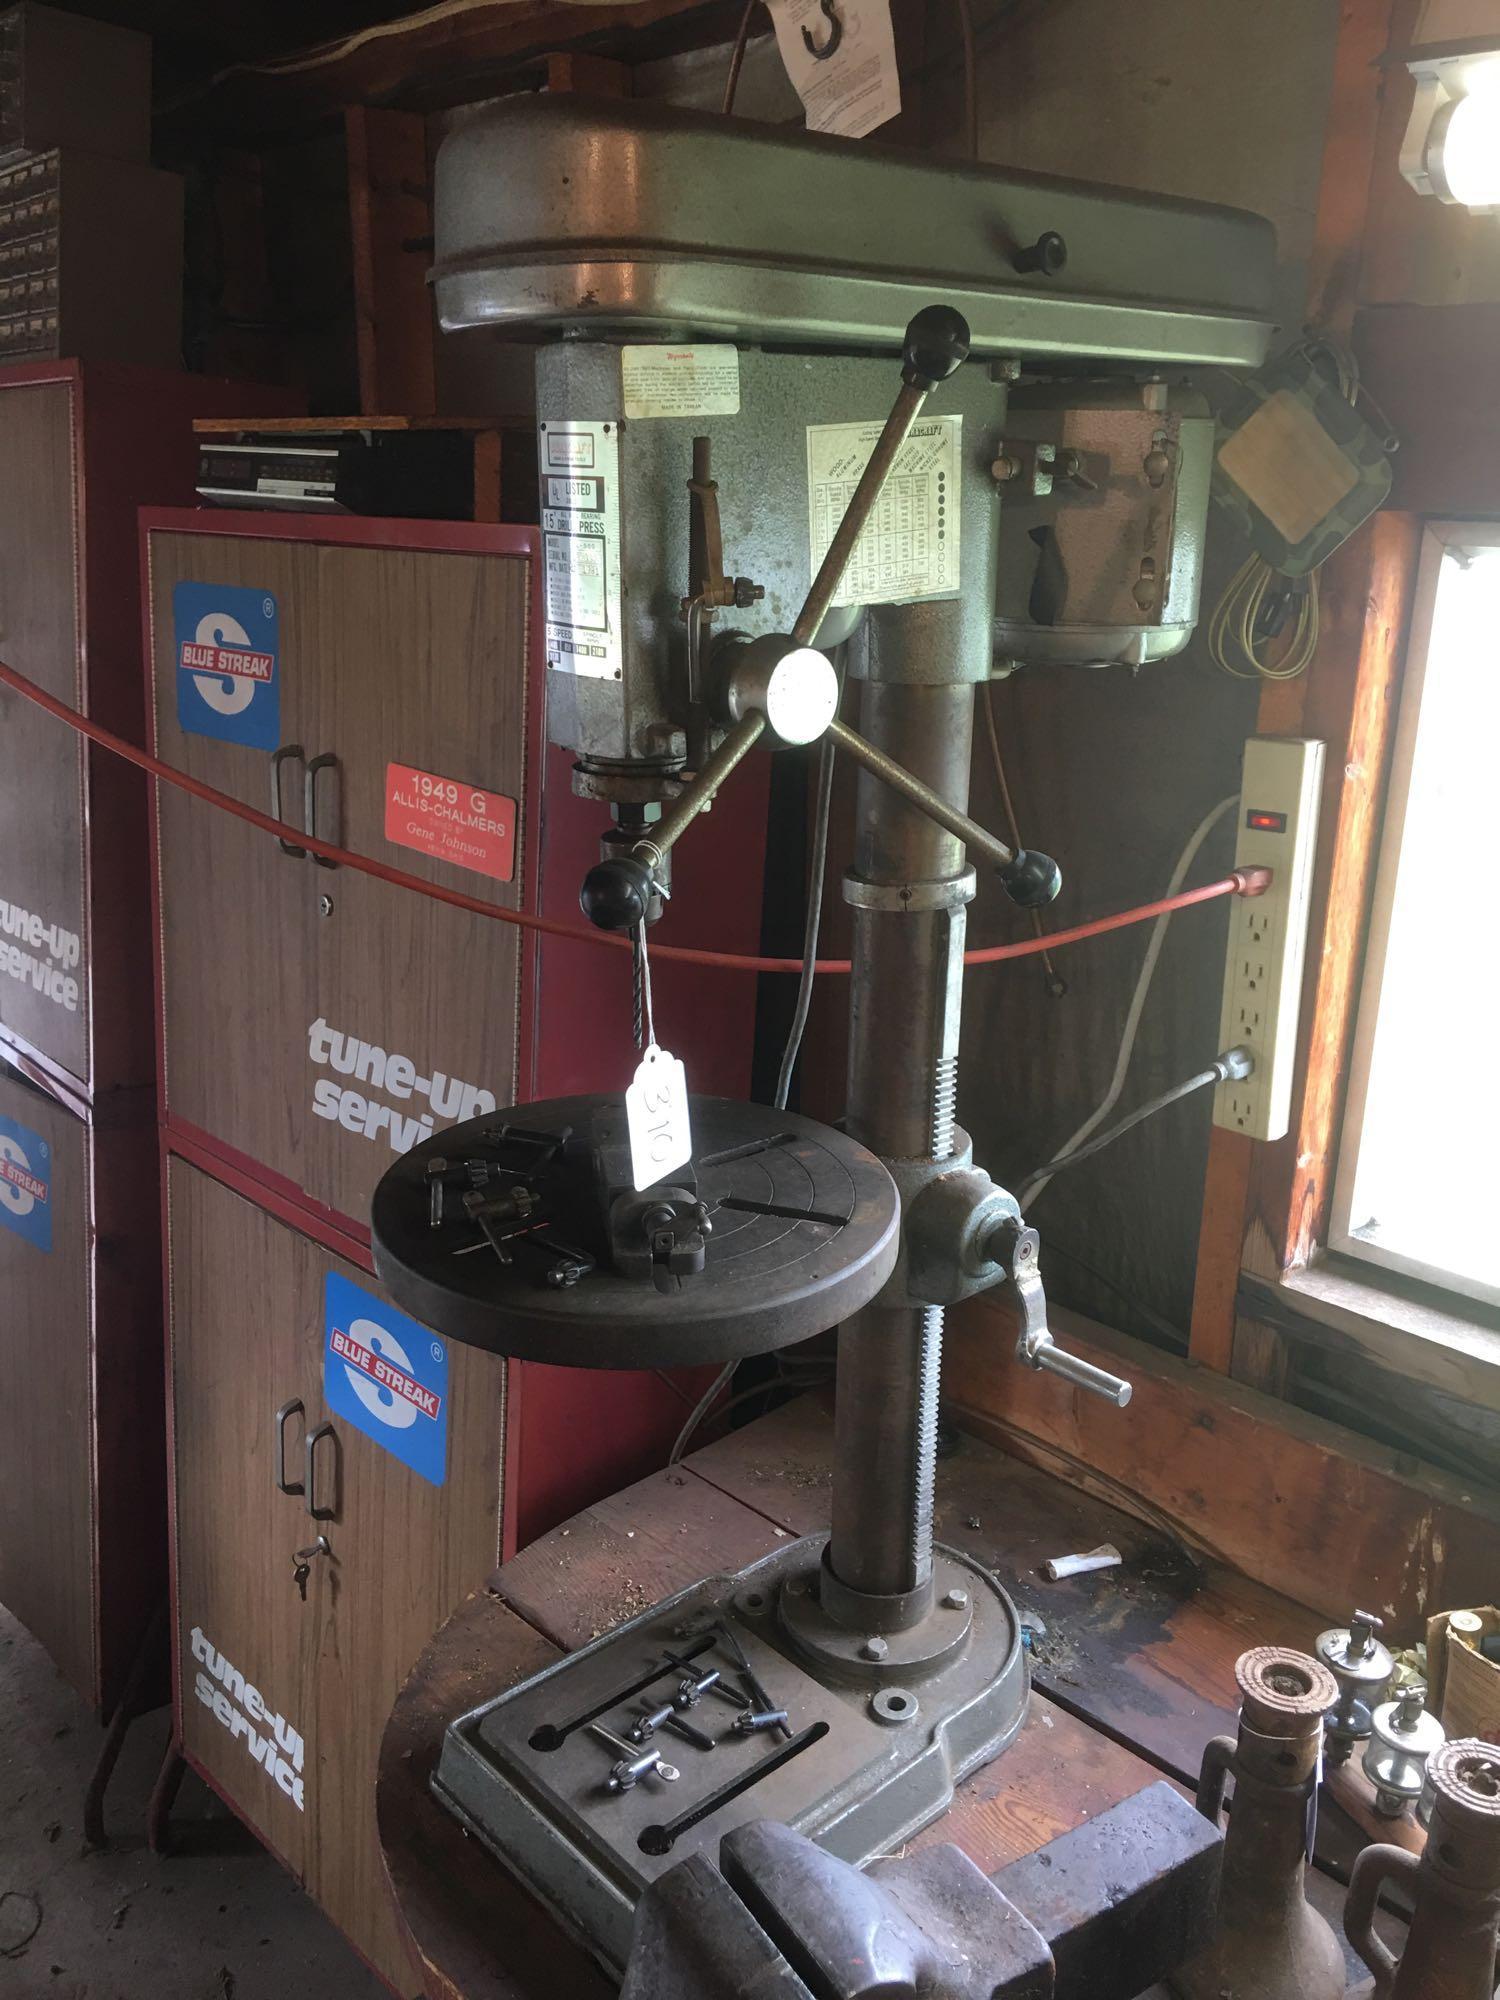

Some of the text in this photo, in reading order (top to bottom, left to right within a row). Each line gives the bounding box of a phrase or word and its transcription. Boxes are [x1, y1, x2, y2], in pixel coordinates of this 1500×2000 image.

[565, 482, 591, 496] LISTED
[579, 521, 605, 534] PRESS
[553, 628, 573, 640] SPEED
[183, 646, 270, 677] BLUE STREAK
[412, 774, 486, 815] 1949 G
[393, 790, 506, 837] ALLIS-CHALMERS
[406, 822, 435, 841] Gene
[441, 833, 487, 858] Johnson
[0, 899, 80, 970] une-up
[308, 1017, 496, 1124] tune-up
[7, 1167, 45, 1199] STREAK
[333, 1333, 435, 1414] BLUE STREAK
